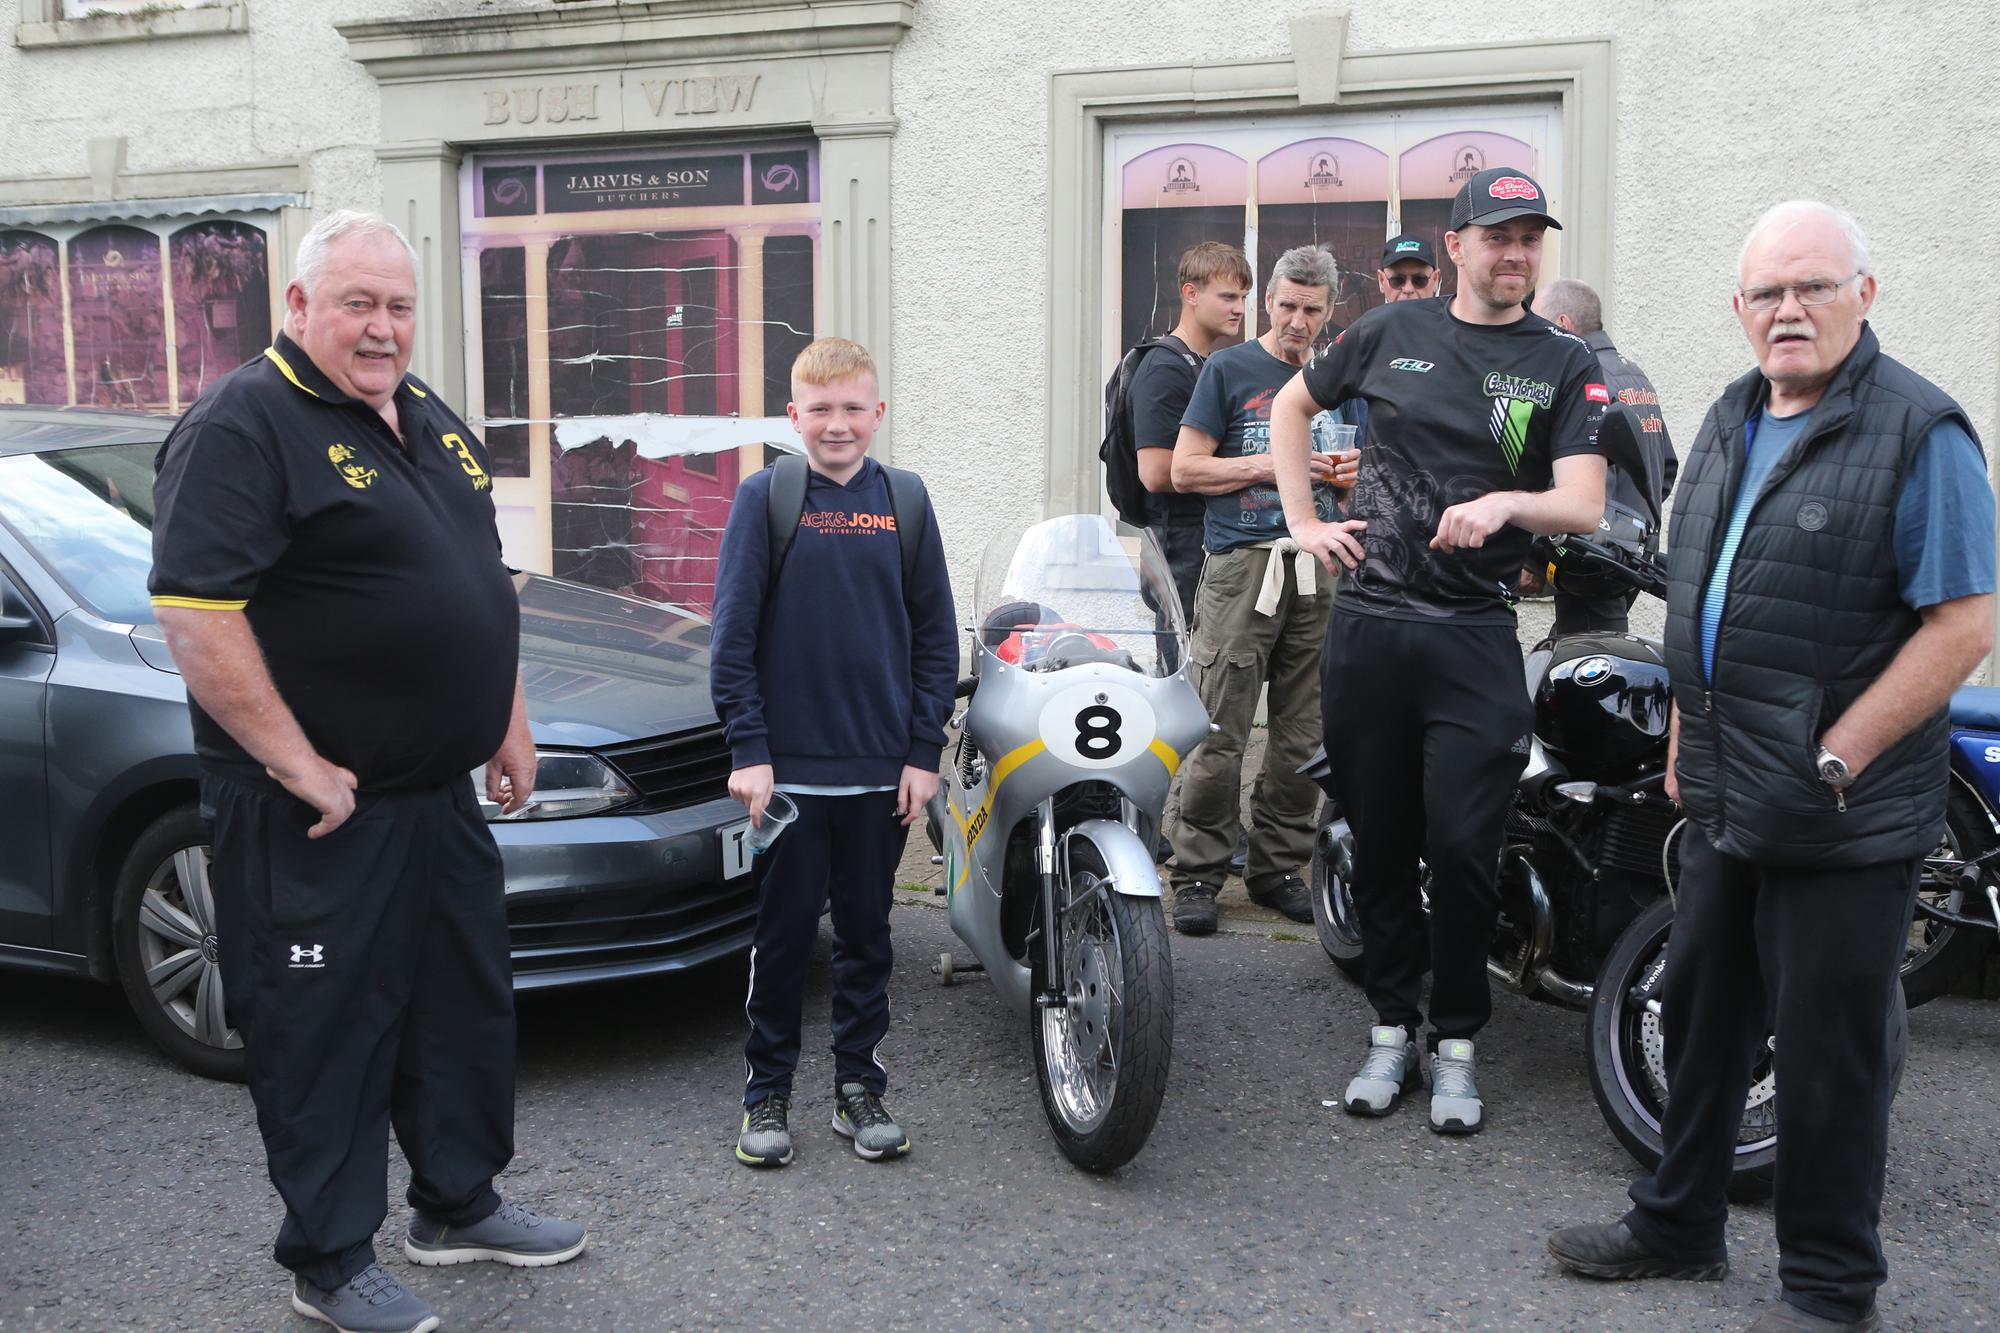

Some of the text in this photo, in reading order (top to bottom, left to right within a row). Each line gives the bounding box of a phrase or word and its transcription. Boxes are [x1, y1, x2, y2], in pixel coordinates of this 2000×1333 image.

[484, 74, 761, 126] BUSH VIEW
[567, 169, 711, 190] JARVIS & SON
[597, 191, 680, 203] BUTCHERS
[442, 433, 483, 476] 3
[1075, 705, 1122, 760] 8
